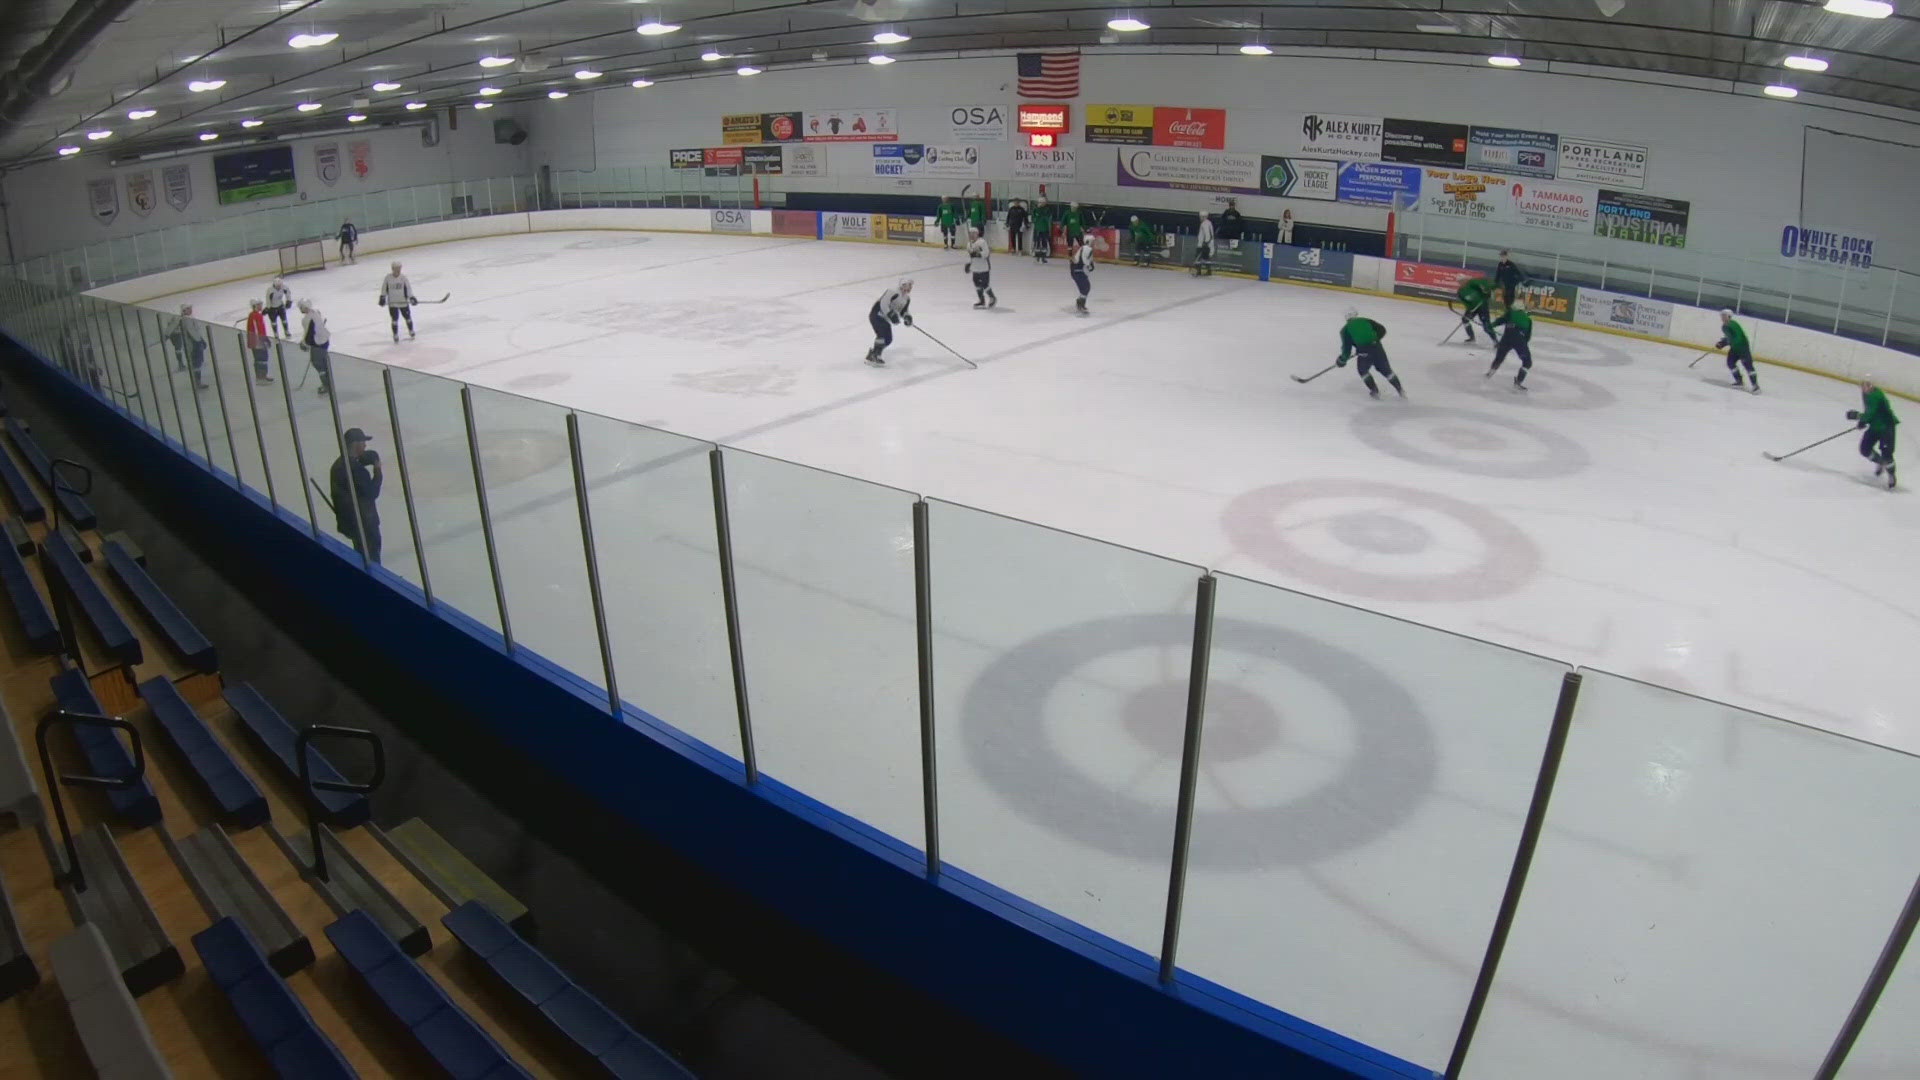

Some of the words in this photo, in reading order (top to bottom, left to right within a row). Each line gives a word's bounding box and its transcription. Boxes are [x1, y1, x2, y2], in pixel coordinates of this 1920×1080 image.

[952, 107, 1003, 125] OSA
[1020, 111, 1063, 122] Hammond
[1326, 121, 1348, 133] ALEX
[1351, 123, 1382, 137] KURTZ
[1384, 132, 1412, 140] Discover
[672, 150, 702, 162] PACE
[1015, 149, 1048, 161] BEV'S
[1052, 150, 1075, 162] BIN
[1302, 145, 1380, 158] AlexKurtzHockey.com
[1562, 144, 1645, 164] PORTLAND
[1197, 155, 1220, 166] HIGH
[1223, 156, 1255, 169] SCHOOL
[875, 164, 903, 175] HOCKEY
[1304, 170, 1330, 180] HOCKEY
[1303, 179, 1329, 190] LEAGUE
[1358, 174, 1402, 184] PERFORMANCE
[1426, 170, 1450, 180] Your
[1453, 172, 1479, 184] Logo
[1482, 176, 1506, 186] Here
[1532, 190, 1584, 204] TAMMARO
[1431, 197, 1447, 207] See
[1448, 199, 1467, 209] Rink
[1470, 202, 1495, 213] Office
[1438, 206, 1453, 214] For
[1455, 207, 1467, 216] Ad
[1520, 201, 1589, 218] LANDSCAPING
[1599, 204, 1651, 219] PORTLAND
[715, 211, 744, 223] OSA
[841, 216, 867, 227] WOLF
[1596, 213, 1683, 237] INDUSTRIAL
[1800, 228, 1838, 248] WHITE
[1842, 236, 1874, 255] ROCK
[1539, 295, 1569, 313] JOE
[1637, 304, 1672, 317] PORTLAND
